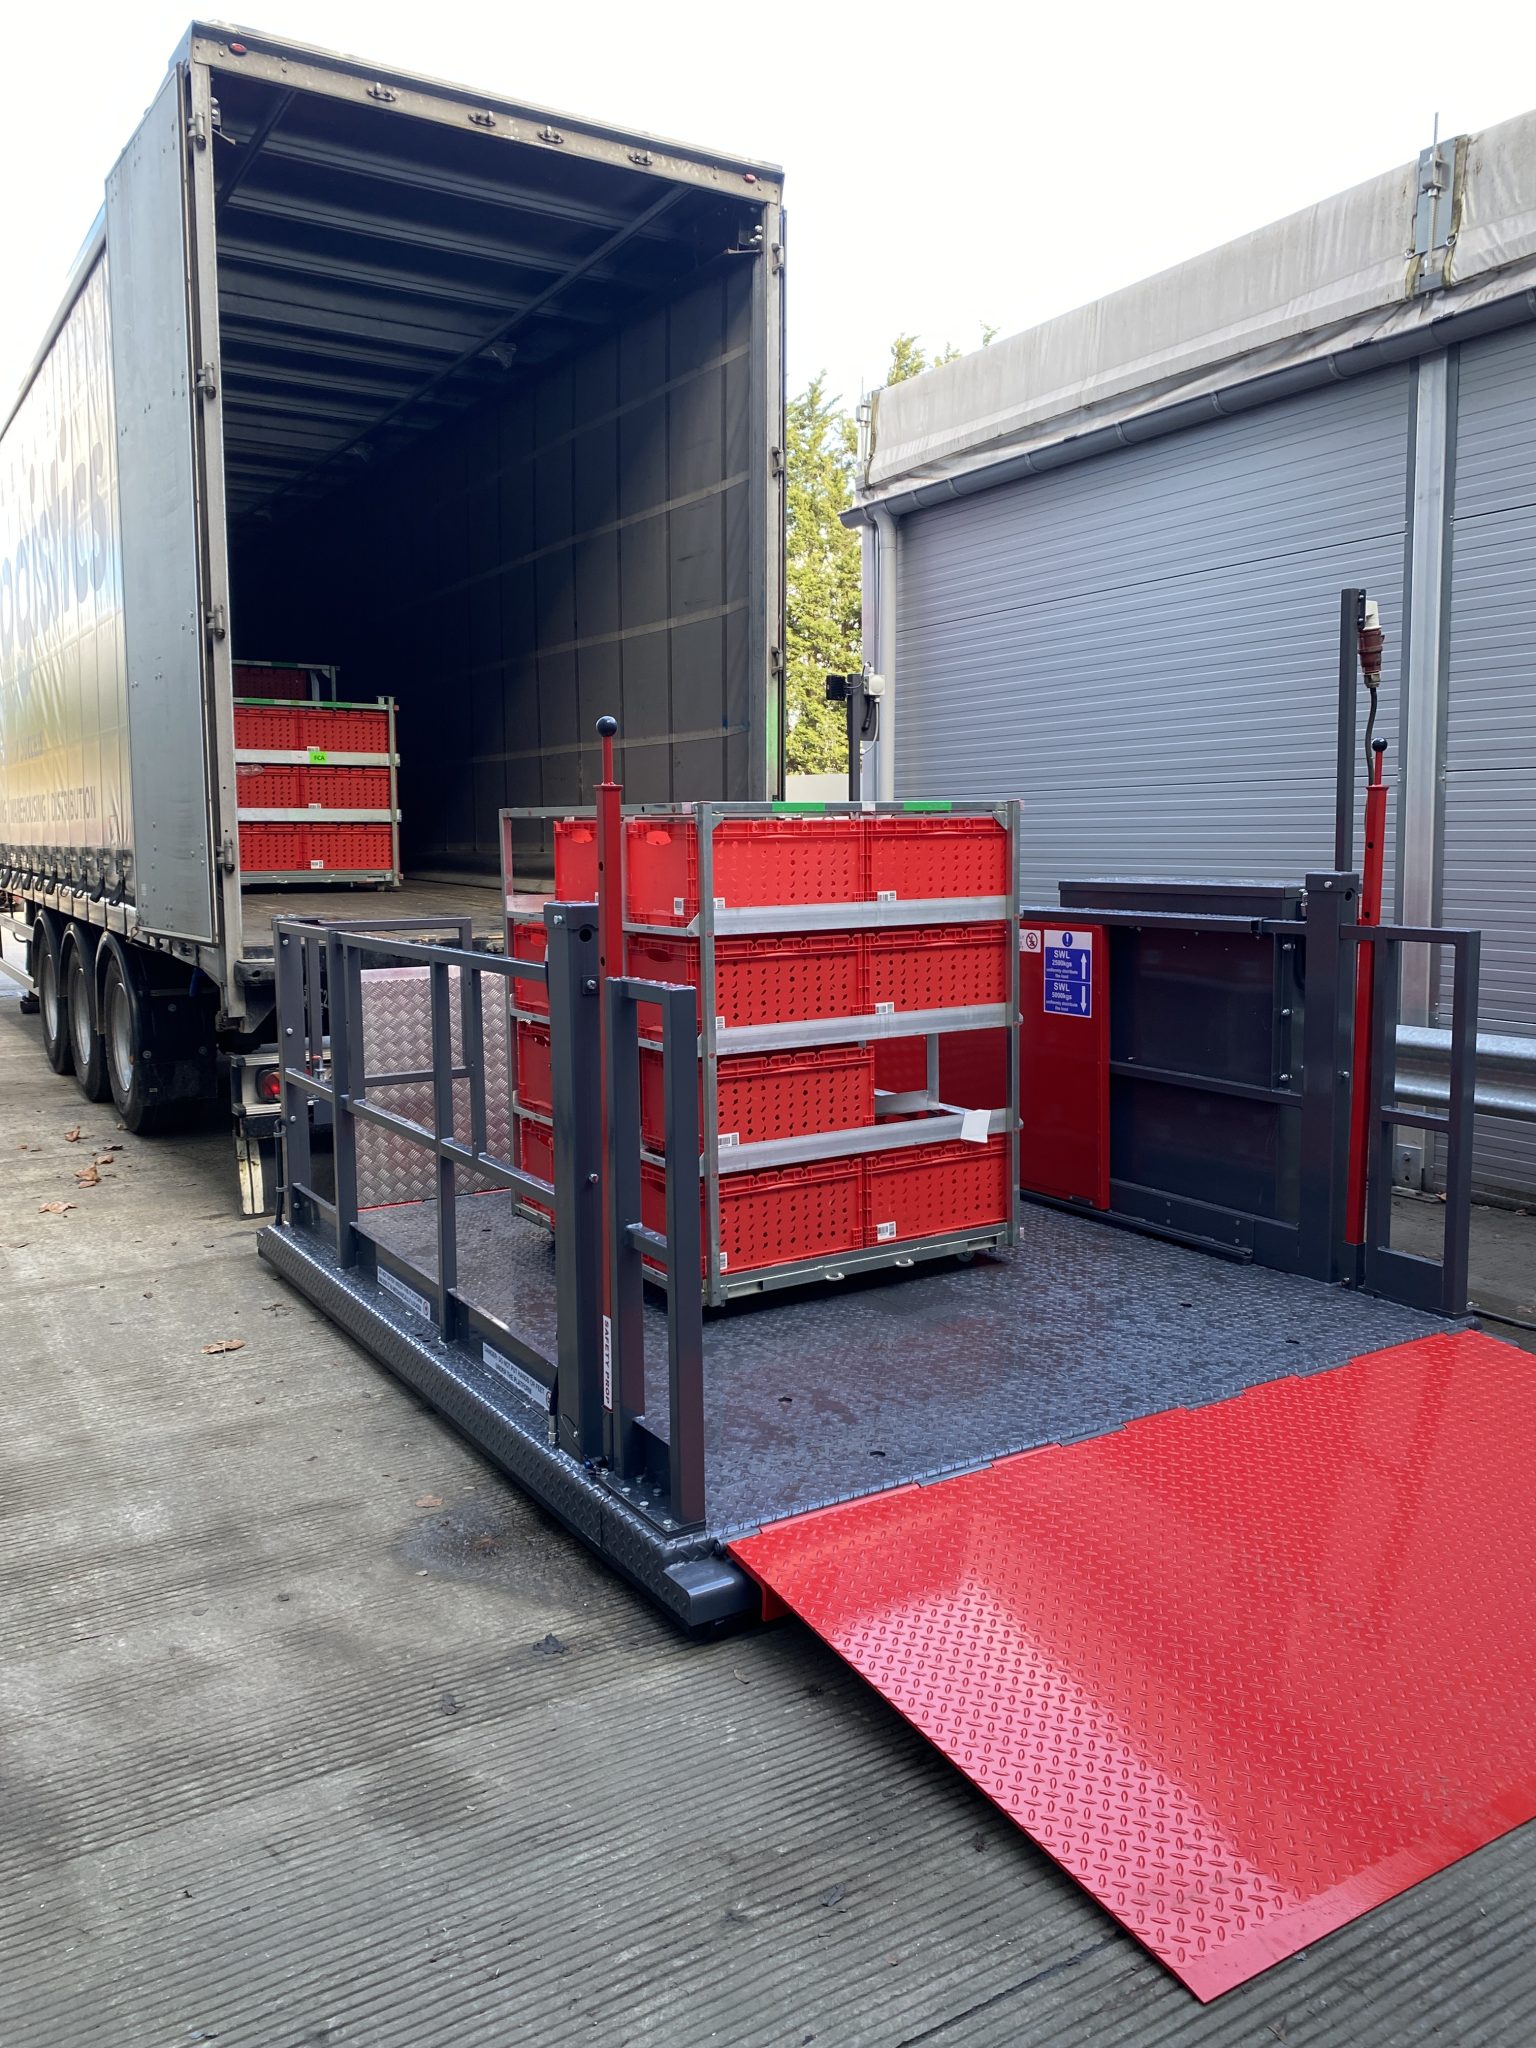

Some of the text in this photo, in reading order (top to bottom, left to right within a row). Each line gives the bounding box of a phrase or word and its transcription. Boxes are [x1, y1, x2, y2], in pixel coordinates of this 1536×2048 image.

[1054, 950, 1070, 959] SWL
[1053, 982, 1070, 992] SWL
[1051, 991, 1072, 1001] 5000kgs
